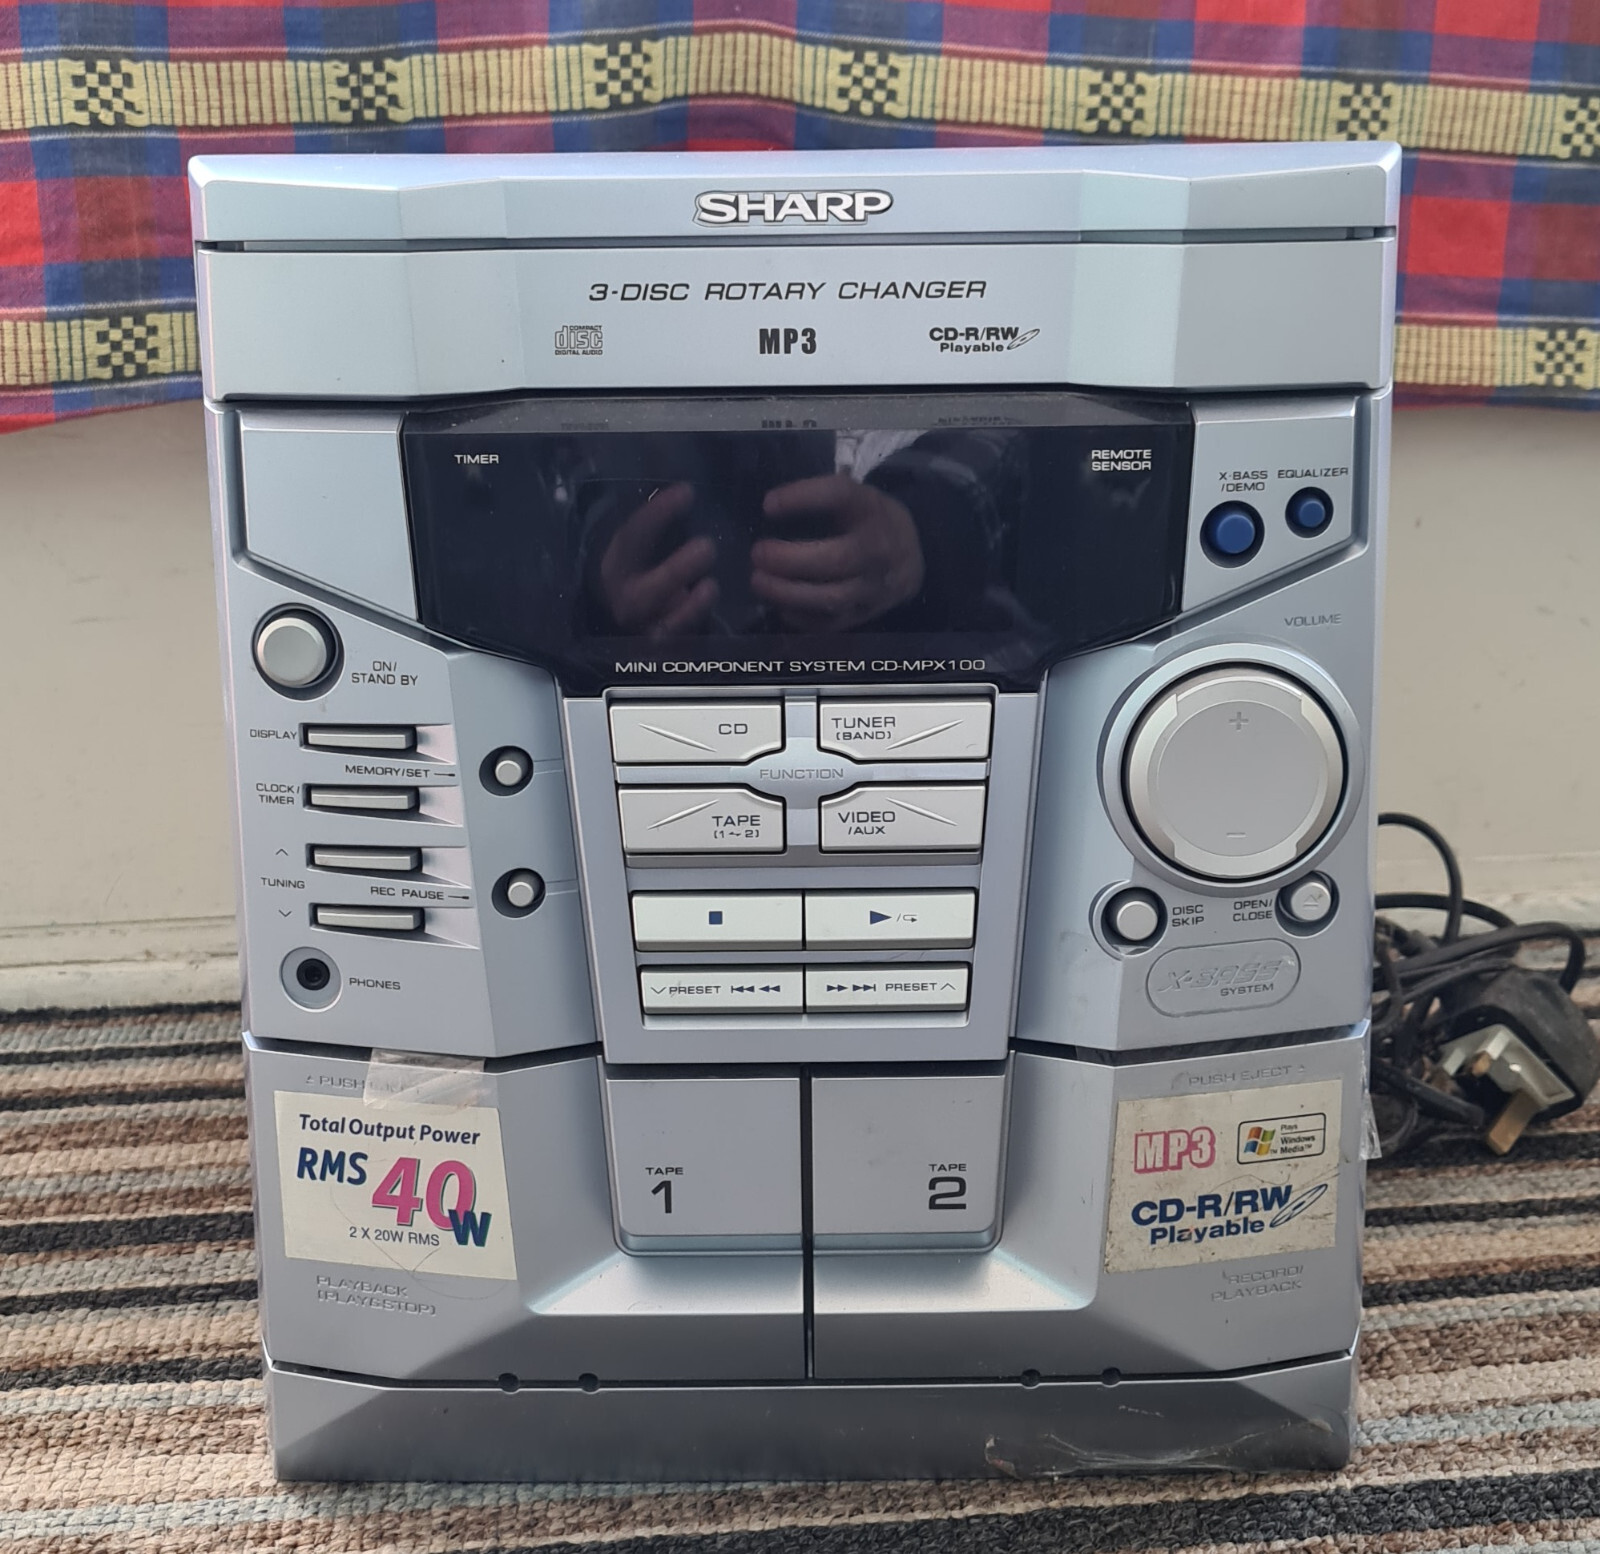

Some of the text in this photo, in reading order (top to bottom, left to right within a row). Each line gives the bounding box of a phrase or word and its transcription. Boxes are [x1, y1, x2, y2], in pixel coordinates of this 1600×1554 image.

[696, 190, 893, 224] SHARP
[589, 280, 988, 301] 3-DISC ROTARY CHANGER
[555, 325, 603, 349] disc
[929, 327, 1019, 341] CD-R/RW
[758, 328, 817, 355] MP3
[940, 342, 1004, 354] Playable
[454, 454, 498, 464] TIMER
[1091, 449, 1152, 460] REMOTE
[1091, 460, 1152, 472] SENSOR
[1277, 467, 1349, 480] EQUALIZER
[1220, 482, 1266, 492] /DEMO
[1284, 614, 1342, 627] VOLUME
[372, 660, 398, 672] ON/
[615, 659, 986, 674] MINI COMPONENT SYSTEM CD-MPX100
[351, 672, 419, 685] STAND BY
[718, 723, 749, 736] CD
[831, 716, 897, 730] TUNER
[249, 728, 298, 740] DISPLAY
[835, 731, 893, 740] (BAND)
[345, 764, 431, 779] MEMORY/SET
[759, 768, 844, 781] FUNCTION
[255, 782, 300, 795] CLOCK/
[258, 794, 295, 806] TIMER
[711, 814, 761, 828] TAPE
[838, 810, 896, 824] VIDEO
[848, 825, 886, 836] /AUX
[260, 876, 306, 890] TUNING
[370, 886, 445, 900] REC PAUSE
[1172, 904, 1204, 916] DISC
[1233, 898, 1273, 911] OPEN/
[1171, 916, 1205, 928] SKIP
[1232, 910, 1273, 922] CLOSE
[349, 977, 401, 991] PHONES
[669, 986, 722, 995] PRESET
[885, 982, 938, 992] PRESET
[1220, 983, 1274, 997] SYSTEM
[319, 1075, 365, 1090] PUSH
[1188, 1065, 1292, 1087] PUSH EJECT
[299, 1113, 481, 1145] Total Output Power
[1280, 1123, 1298, 1132] Plays
[1280, 1135, 1316, 1145] Windows
[1134, 1126, 1216, 1174] MP3
[296, 1147, 369, 1186] RMS
[646, 1167, 684, 1175] TAPE
[929, 1163, 967, 1172] TAPE
[651, 1180, 672, 1214] 1
[928, 1176, 967, 1210] 2
[1131, 1185, 1292, 1226] CD-R/RW
[349, 1226, 440, 1247] 2 X 20W RMS
[1150, 1219, 1265, 1245] Playable
[316, 1275, 408, 1298] PLAYBACK
[1211, 1279, 1302, 1303] PLAYBACK
